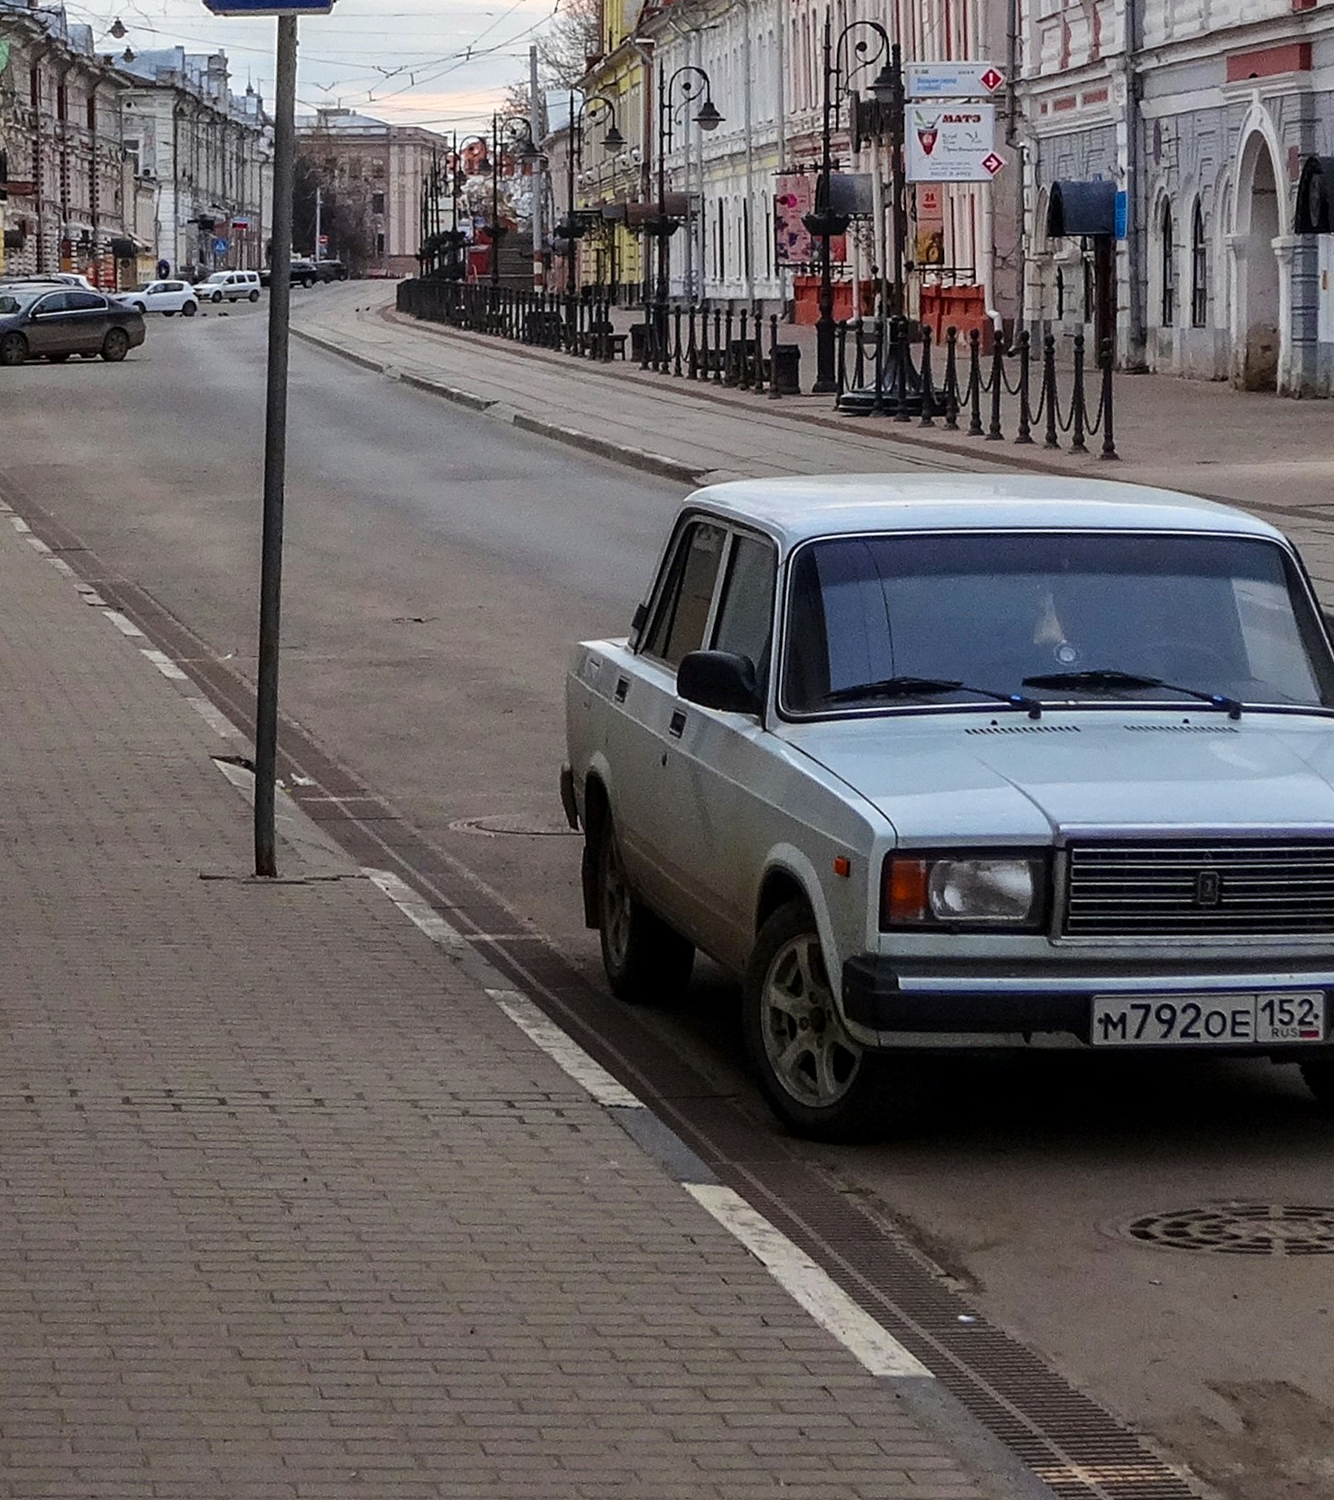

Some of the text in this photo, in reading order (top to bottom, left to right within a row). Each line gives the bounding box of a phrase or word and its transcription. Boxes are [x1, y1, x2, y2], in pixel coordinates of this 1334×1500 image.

[1102, 998, 1315, 1040] М792ОЕ 152
[1271, 1027, 1299, 1038] RUS
